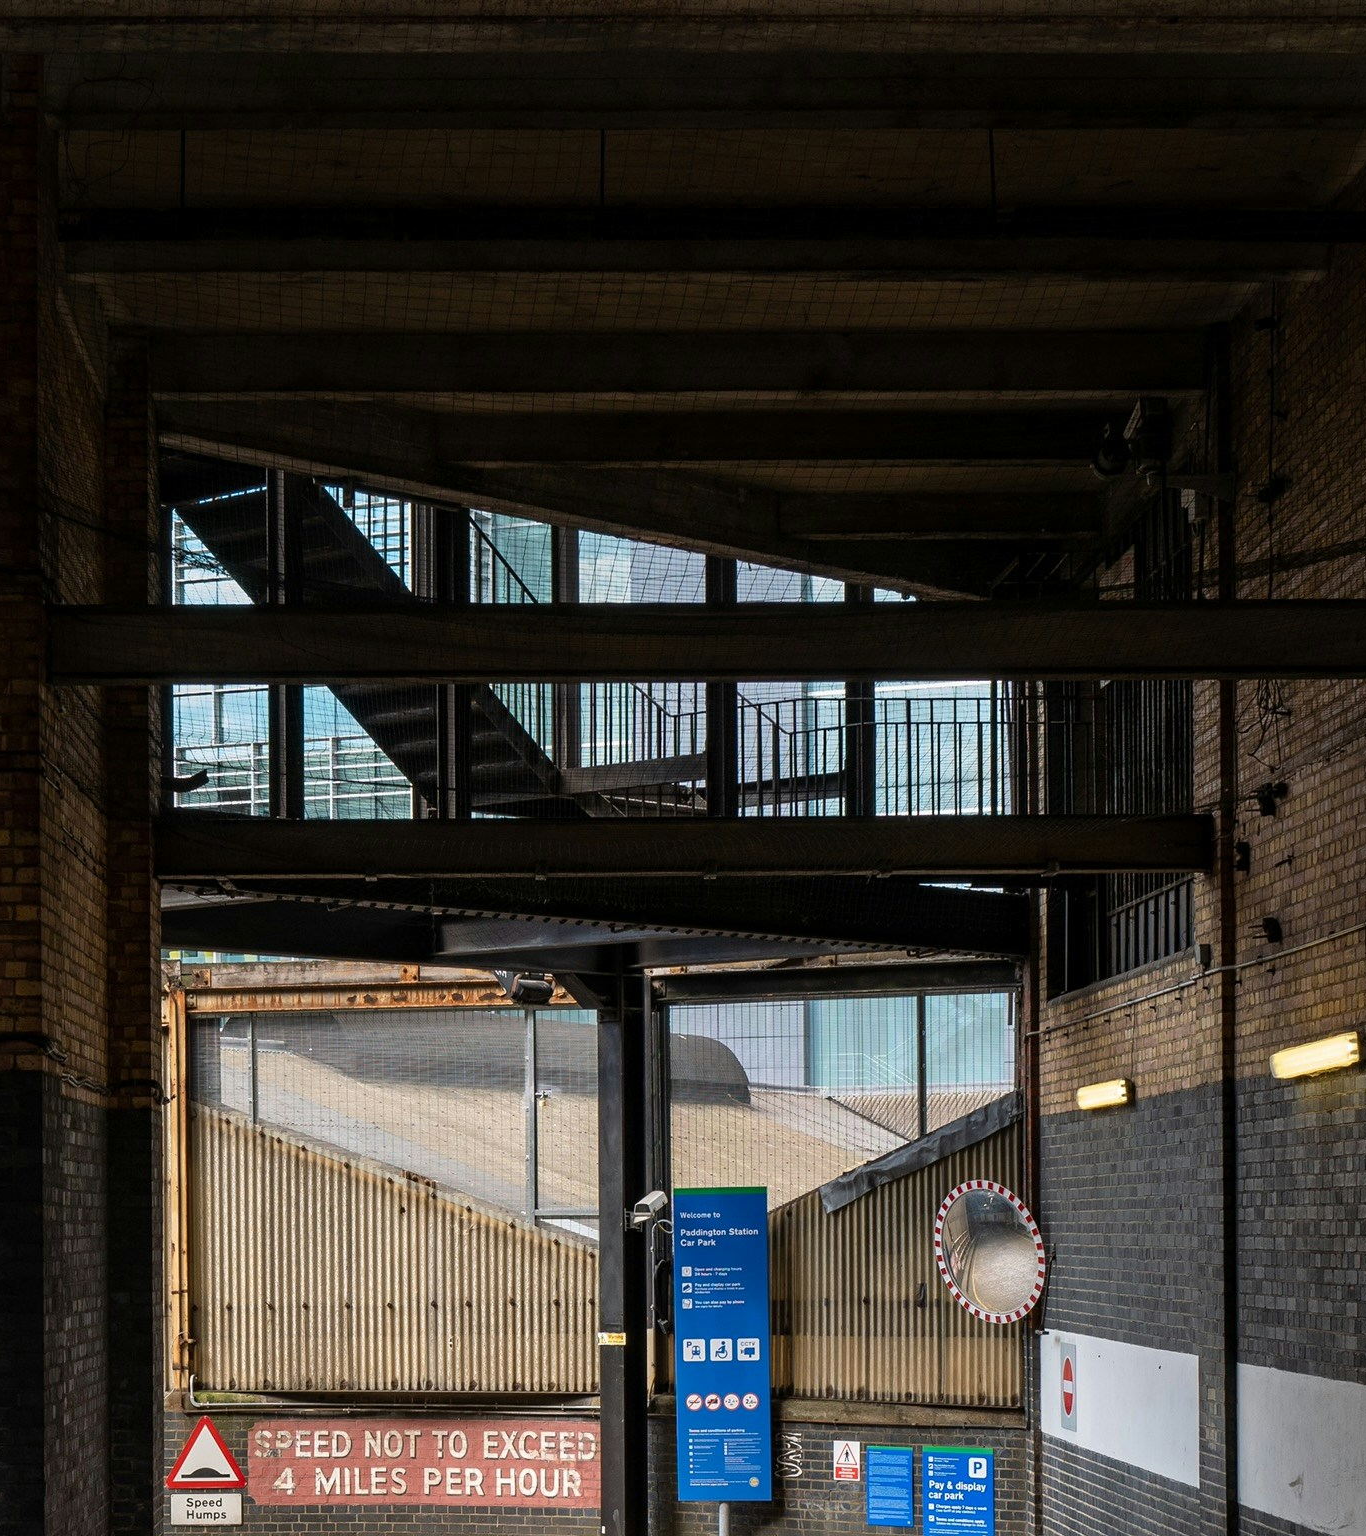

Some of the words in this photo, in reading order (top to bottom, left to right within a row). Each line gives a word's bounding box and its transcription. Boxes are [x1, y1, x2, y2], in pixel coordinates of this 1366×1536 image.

[681, 1229, 726, 1237] Paddington
[729, 1228, 759, 1236] Station
[254, 1430, 352, 1458] SPEED
[365, 1430, 422, 1458] NOT
[431, 1430, 468, 1459] TO
[483, 1430, 597, 1461] EXCEED
[974, 1462, 982, 1474] P
[272, 1467, 296, 1495] 4
[315, 1467, 407, 1496] MILES
[423, 1467, 485, 1496] PER
[495, 1468, 582, 1498] HOUR
[929, 1480, 945, 1491] Pay
[947, 1481, 953, 1490] &
[955, 1482, 986, 1492] display
[944, 1492, 964, 1501] park
[186, 1498, 222, 1508] Speed
[187, 1510, 227, 1521] Humps
